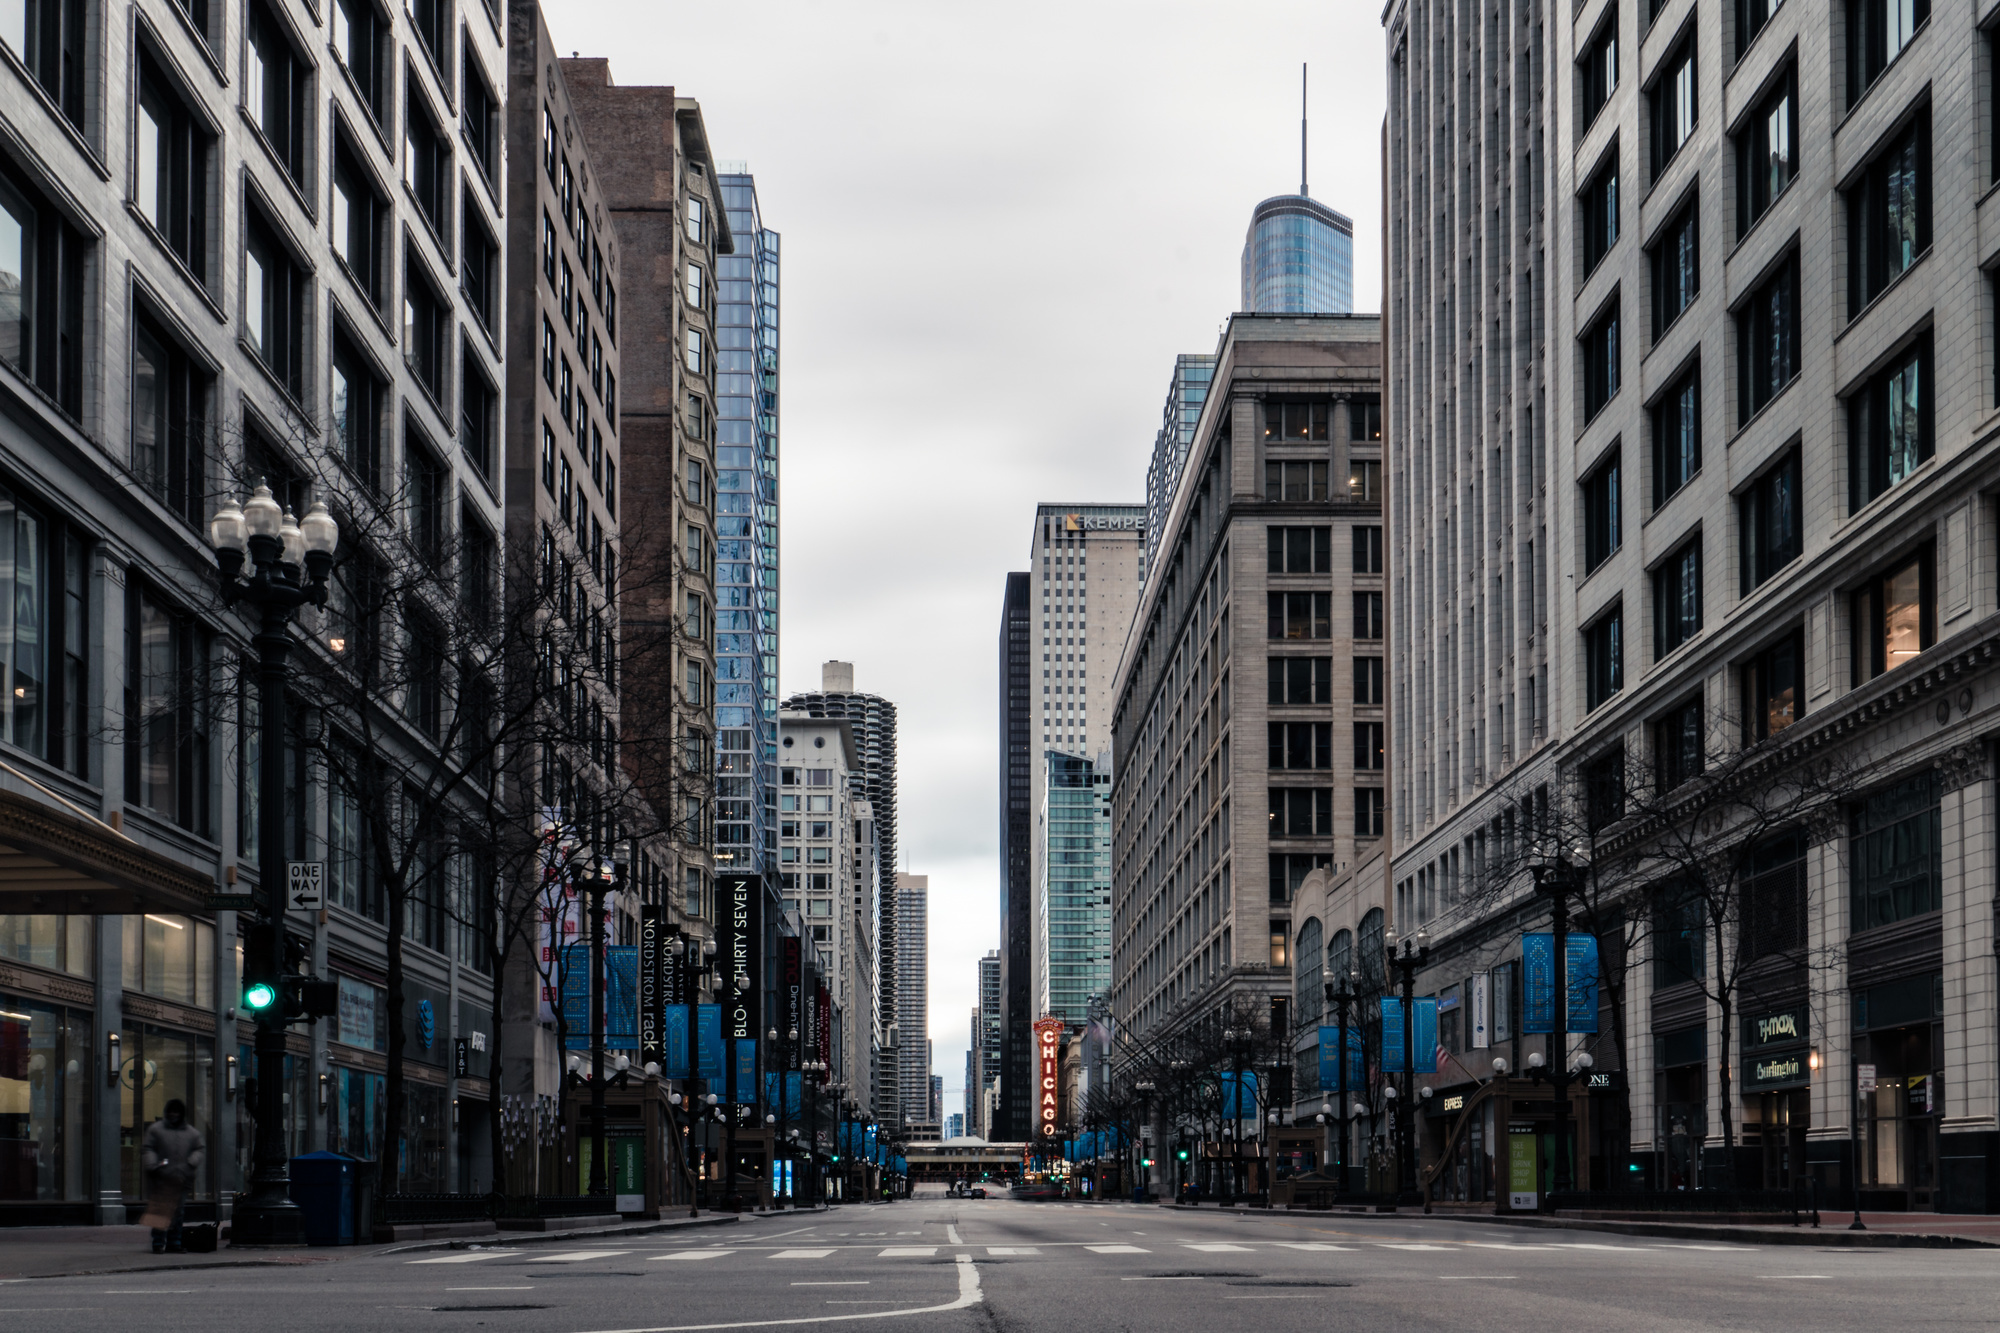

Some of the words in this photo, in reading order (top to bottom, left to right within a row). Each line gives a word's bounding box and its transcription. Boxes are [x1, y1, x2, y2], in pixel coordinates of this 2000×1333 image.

[1084, 516, 1145, 529] KEMPE
[291, 879, 319, 891] WAY
[292, 866, 319, 877] ONE
[734, 881, 747, 928] SEVEN
[643, 918, 655, 1007] NORDSTROM
[663, 936, 674, 1018] NORDSTRO
[734, 932, 747, 982] THIRTY
[734, 987, 747, 1037] BLOK
[790, 985, 799, 1021] Dine-In
[805, 996, 814, 1047] francesca's
[643, 1013, 659, 1051] rack
[1043, 1030, 1055, 1135] CHICAGO
[1757, 1057, 1799, 1080] Burlington
[1444, 1095, 1463, 1111] EXPRESS
